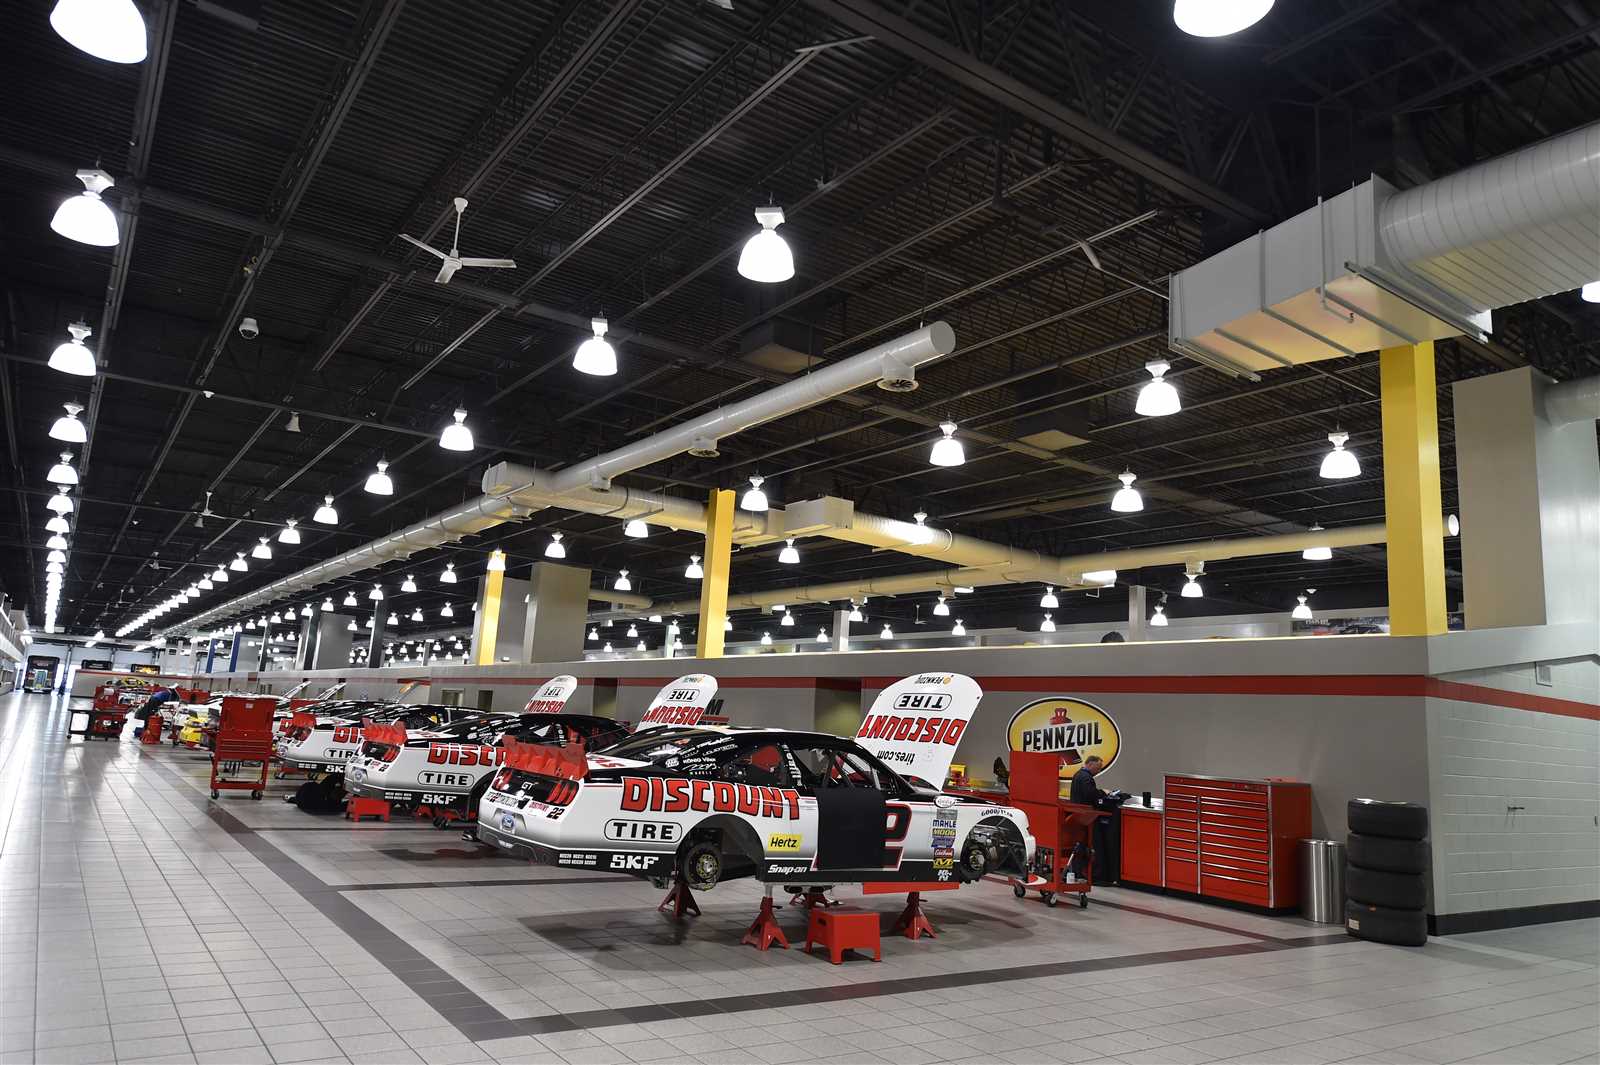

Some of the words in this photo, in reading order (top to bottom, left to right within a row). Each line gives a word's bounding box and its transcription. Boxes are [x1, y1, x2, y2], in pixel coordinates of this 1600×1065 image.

[898, 695, 943, 708] TIRE
[857, 714, 968, 746] DISCOUNT
[1023, 721, 1102, 752] PENNZOIL
[877, 750, 915, 765] tires.com
[325, 764, 345, 773] SK
[424, 773, 468, 785] TIRE
[421, 793, 457, 804] SKF
[621, 776, 800, 820] DISCOUNT
[546, 807, 565, 819] 22
[932, 820, 956, 828] MAHLE
[613, 822, 674, 840] TIRE
[770, 837, 798, 848] Hertz
[610, 854, 659, 869] SKF
[768, 864, 807, 875] Snap-on
